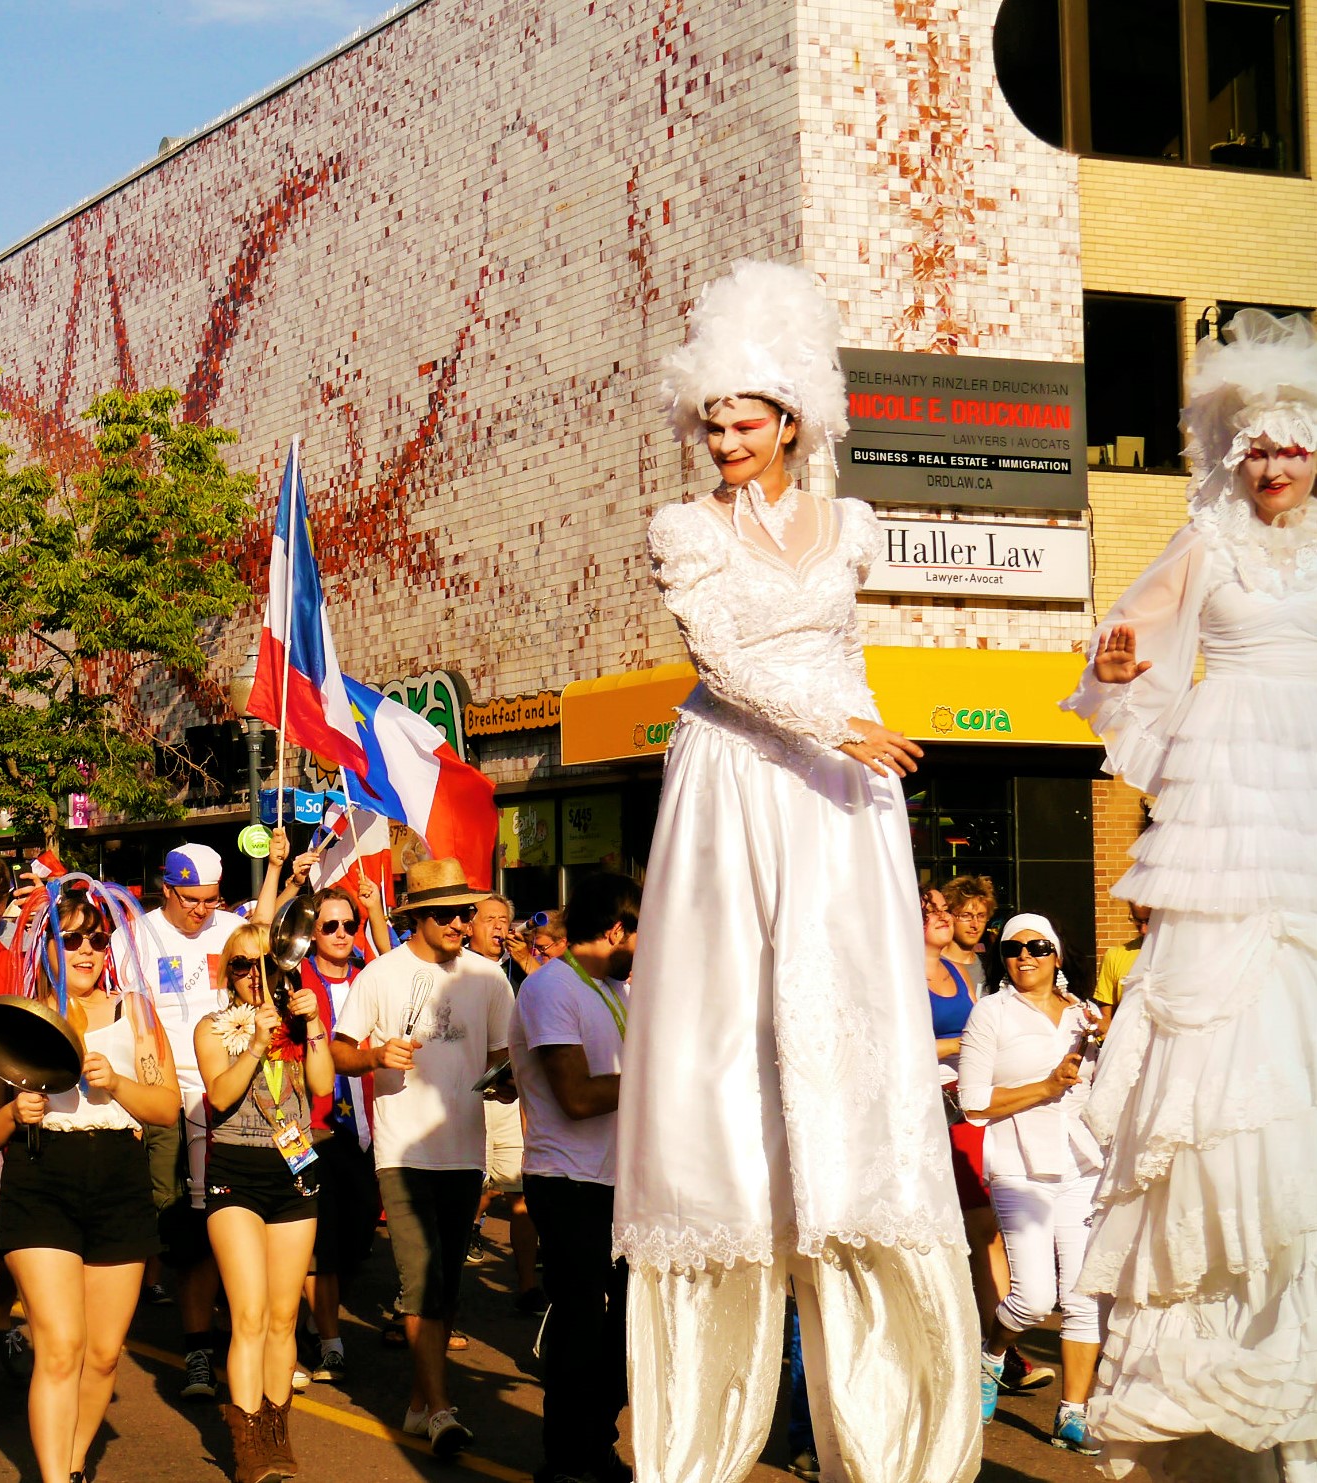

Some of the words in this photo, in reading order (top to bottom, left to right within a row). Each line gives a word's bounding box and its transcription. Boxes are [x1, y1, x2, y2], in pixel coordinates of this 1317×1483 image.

[848, 370, 928, 387] DELEHANTY
[932, 376, 988, 391] RINZLER
[992, 380, 1069, 396] DRUCKMAN
[848, 392, 924, 422] NICOLE
[928, 397, 947, 423] E.
[951, 399, 1071, 430] DRUCKMAN
[953, 434, 1007, 447] LAWYERS
[1017, 438, 1070, 450] AVOCATS
[853, 450, 909, 464] BUSINESS
[918, 454, 947, 465] REAL
[950, 455, 988, 468] ESTATE
[998, 458, 1069, 471] IMMIGRATION
[926, 474, 993, 490] DRDLAW.CA
[884, 528, 977, 566] Haller
[985, 533, 1045, 569] Law
[468, 704, 522, 730] Breakfast
[525, 700, 544, 719] and
[955, 709, 1012, 733] cora
[184, 957, 207, 991] GODIN
